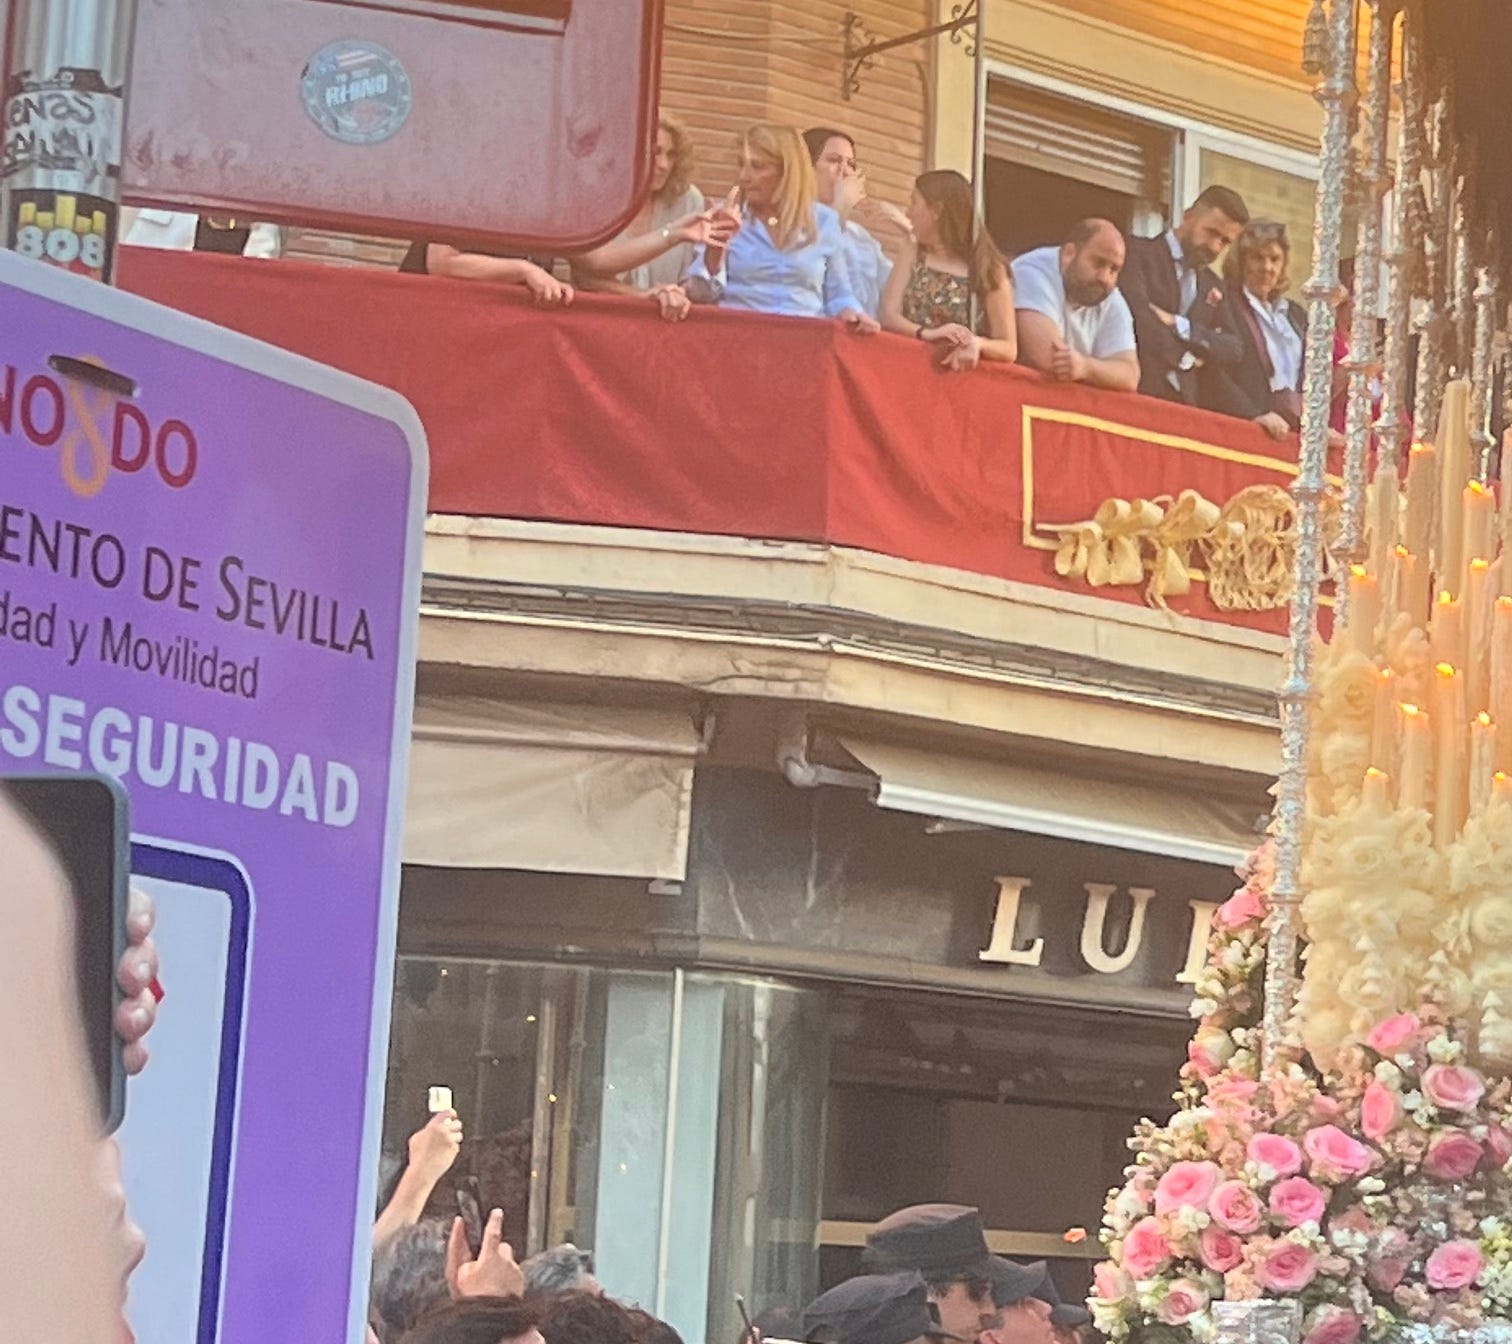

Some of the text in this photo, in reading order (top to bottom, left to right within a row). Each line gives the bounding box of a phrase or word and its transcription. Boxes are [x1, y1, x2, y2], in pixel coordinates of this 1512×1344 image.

[67, 619, 89, 667] y
[99, 617, 260, 699] Movilidad
[143, 546, 202, 611] DE
[216, 555, 375, 660] SEVILLA
[2, 683, 360, 829] SEGURIDAD
